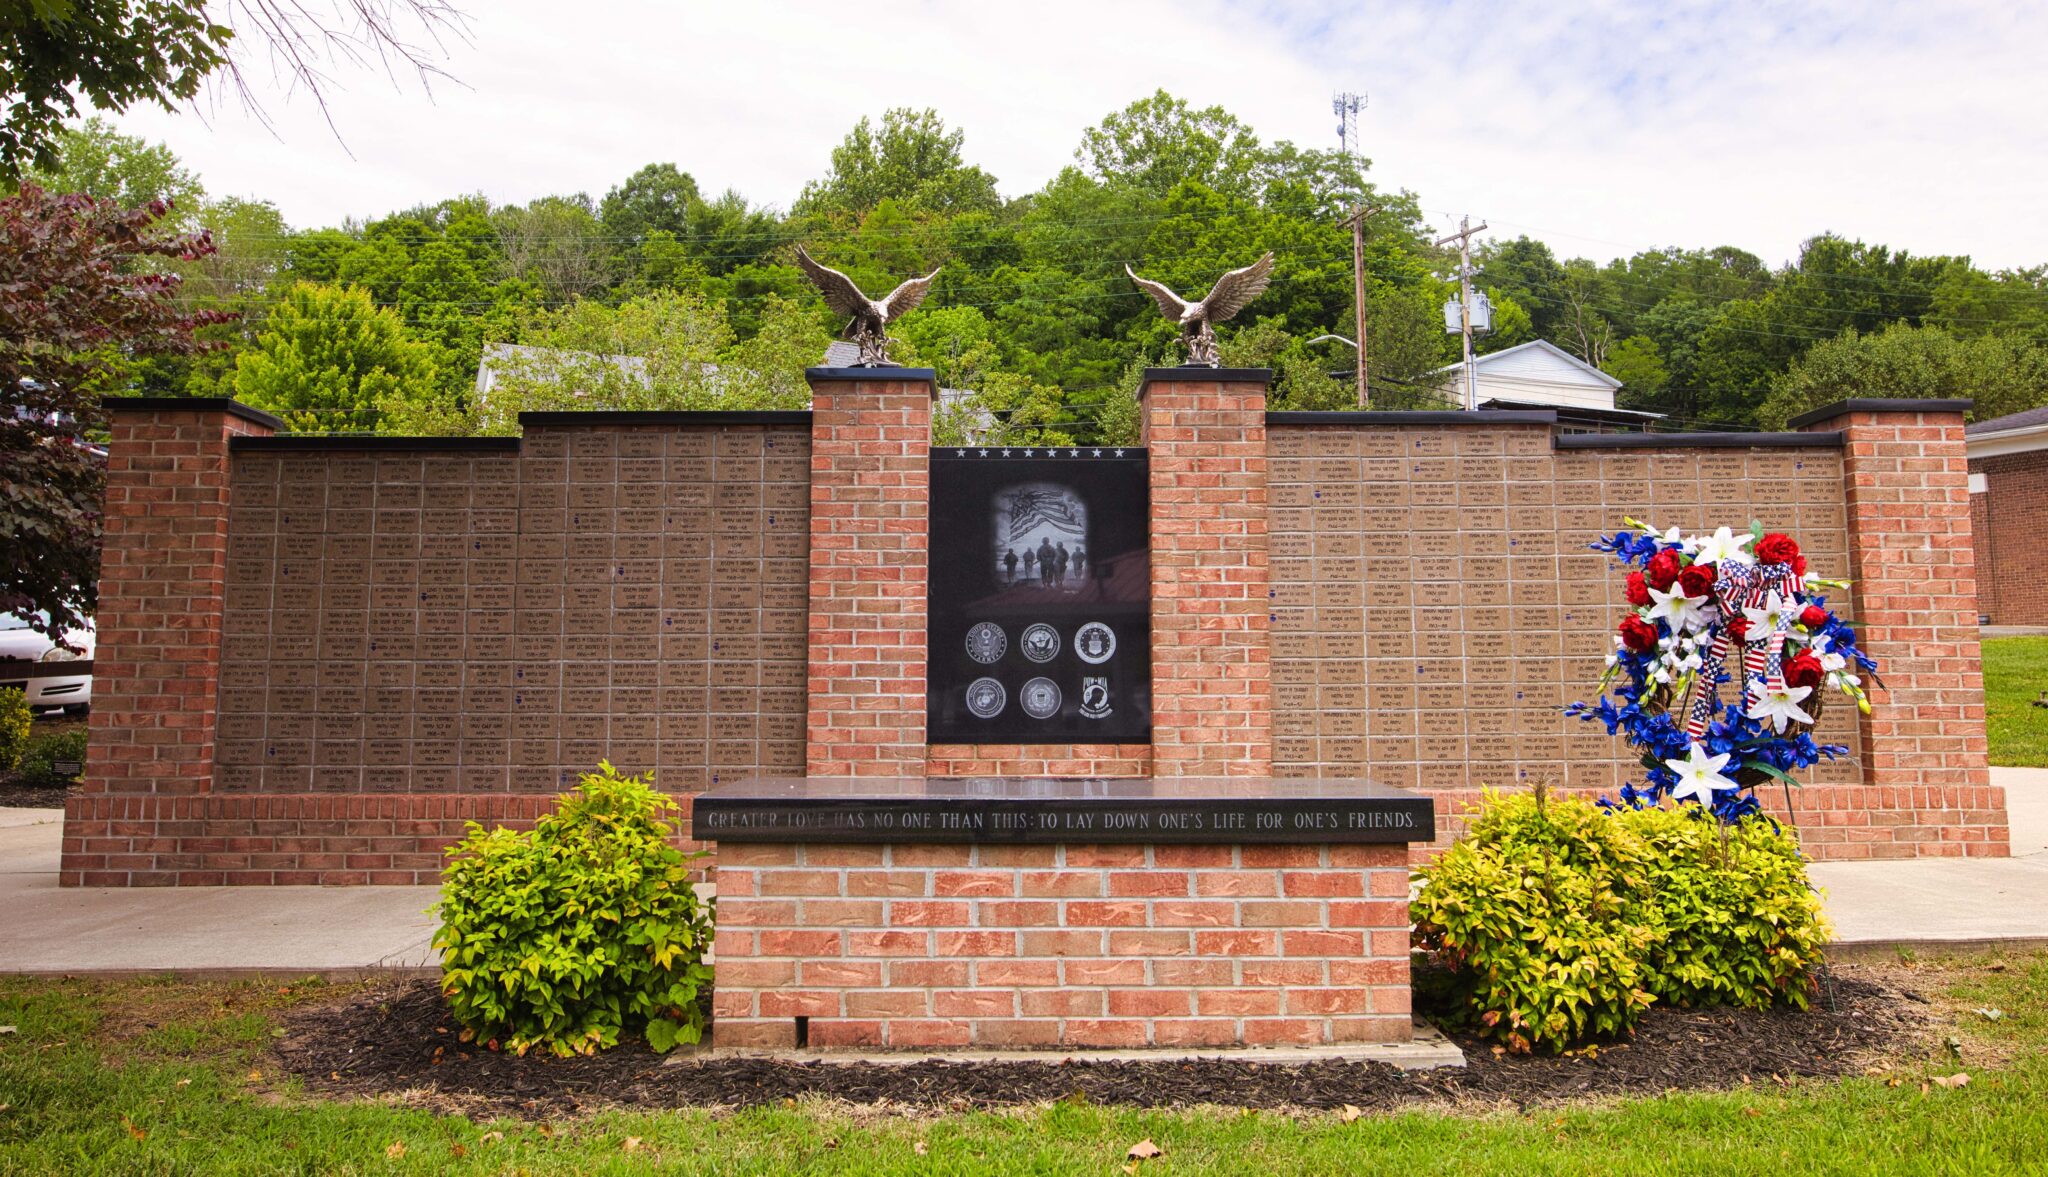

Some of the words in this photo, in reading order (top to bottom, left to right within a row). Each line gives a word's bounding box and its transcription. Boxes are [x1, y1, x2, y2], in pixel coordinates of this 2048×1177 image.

[708, 812, 777, 828] GREATER
[787, 812, 825, 828] LOVE
[834, 812, 865, 828] HAS
[873, 813, 894, 829] NO
[902, 812, 932, 829] ONE
[940, 812, 983, 829] THAN
[1038, 813, 1058, 829] TO
[1066, 813, 1094, 829] LAY
[1104, 813, 1149, 829] DOWN
[1159, 813, 1203, 829] ONE'S
[1213, 813, 1246, 829] LIFE
[1256, 813, 1284, 829] FOR
[1294, 812, 1338, 829] ONE'S
[1349, 812, 1418, 828] FRIENDS.
